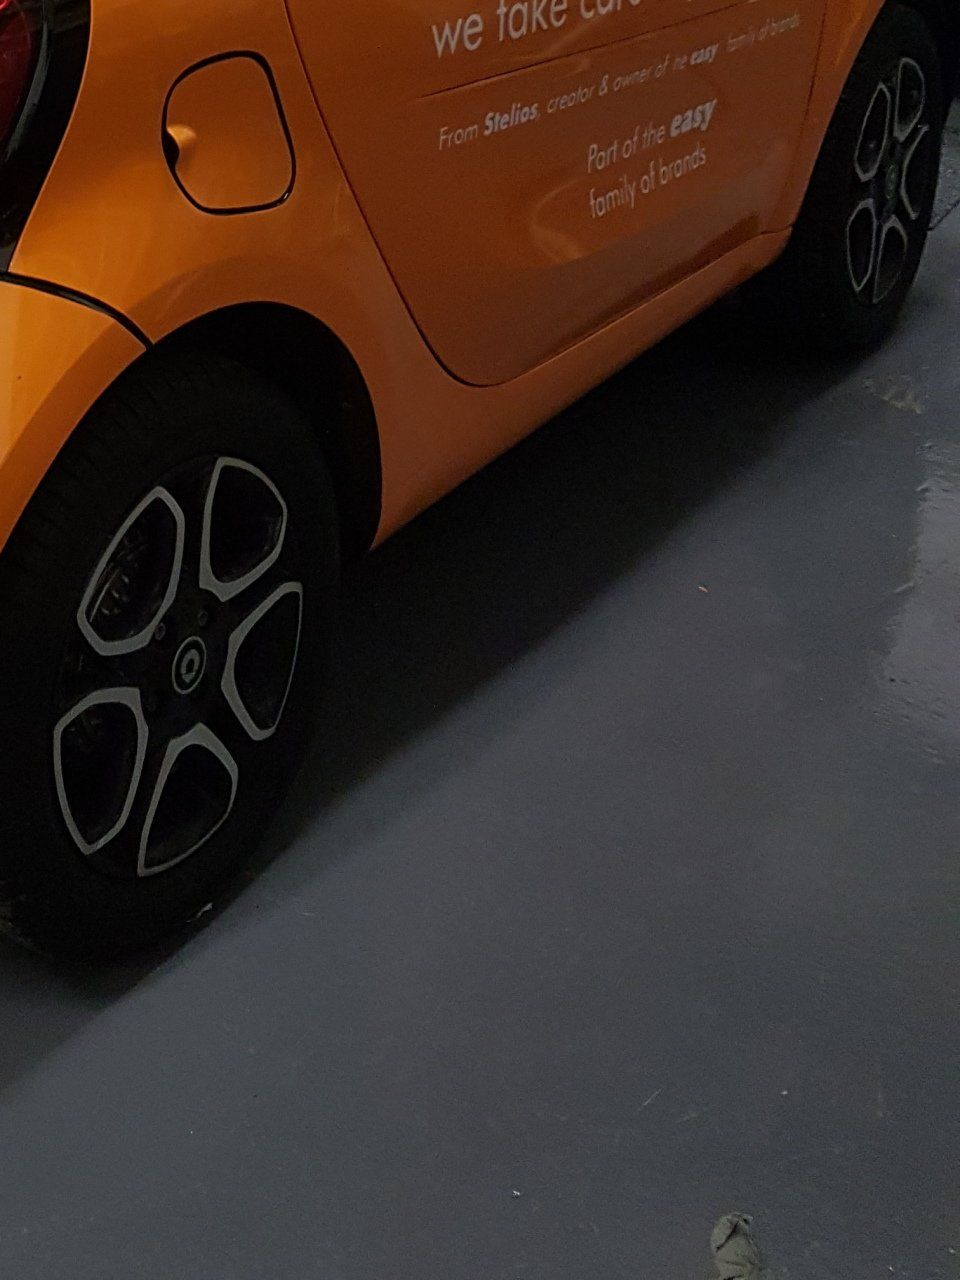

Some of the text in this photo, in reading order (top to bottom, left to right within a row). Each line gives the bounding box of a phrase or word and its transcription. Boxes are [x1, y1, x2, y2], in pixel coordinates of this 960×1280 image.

[431, 8, 483, 59] we
[439, 124, 478, 150] From
[547, 86, 595, 114] creator
[598, 75, 609, 96] &
[613, 67, 651, 91] owner
[588, 98, 717, 173] Part of the easy
[590, 140, 706, 219] family of brands
